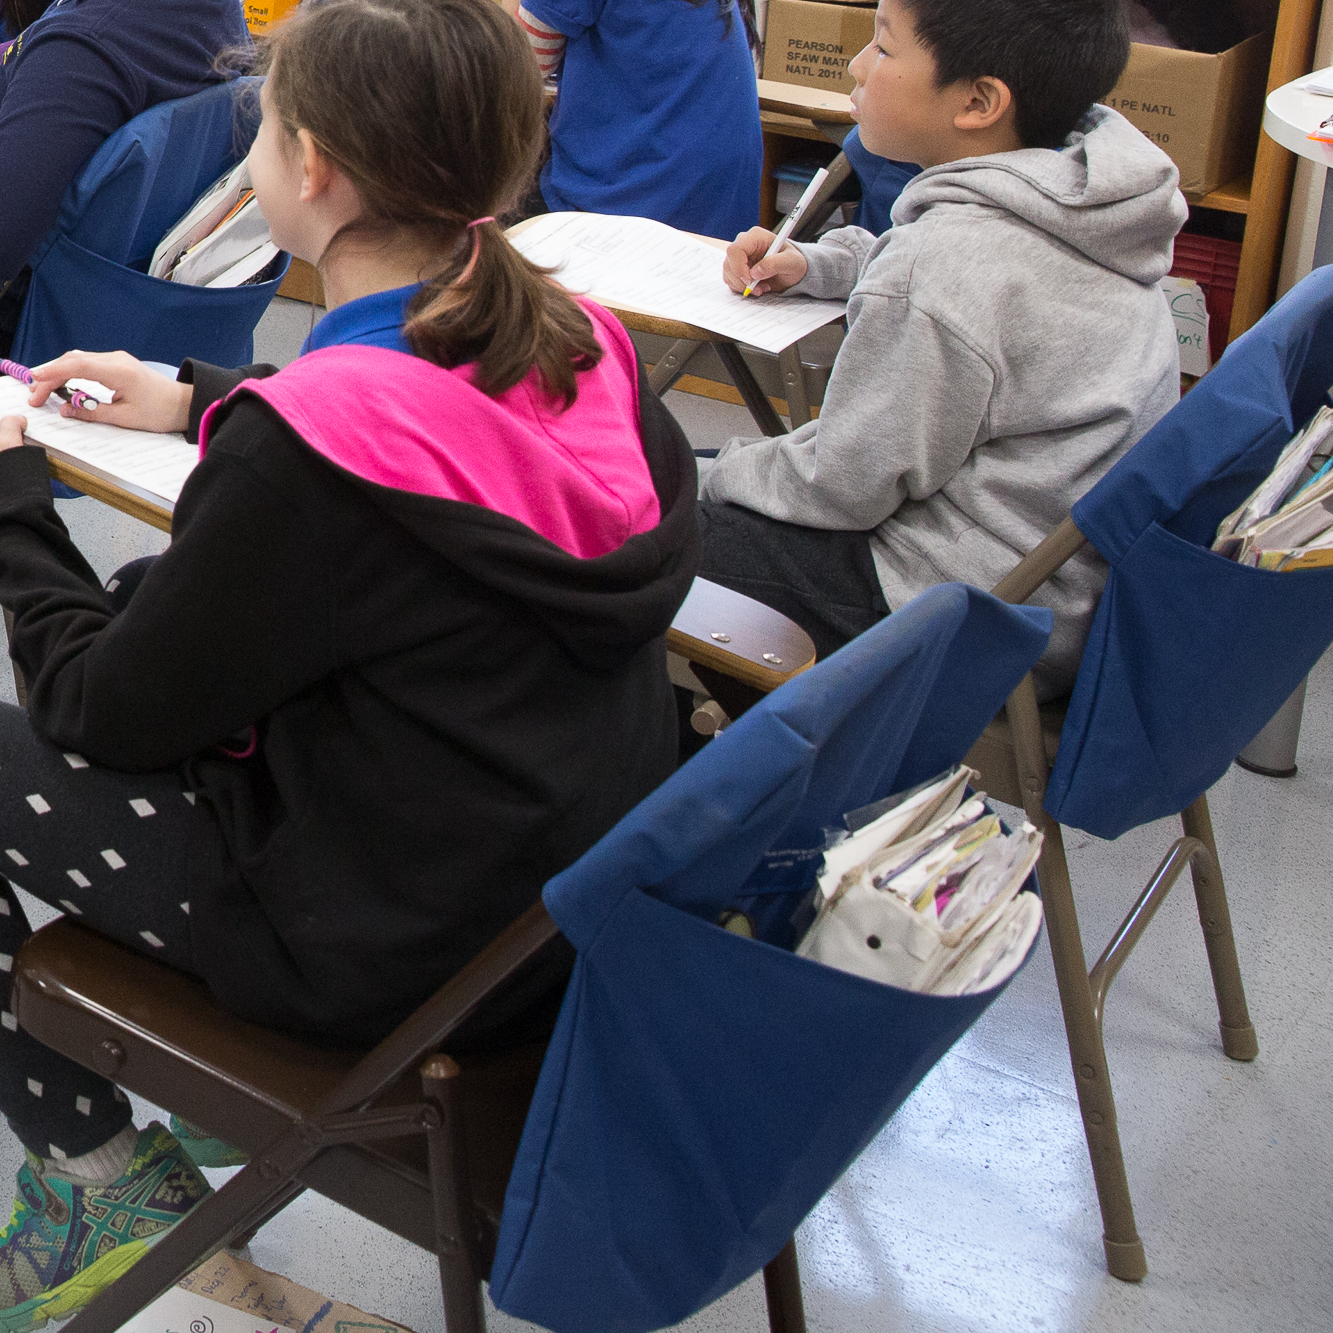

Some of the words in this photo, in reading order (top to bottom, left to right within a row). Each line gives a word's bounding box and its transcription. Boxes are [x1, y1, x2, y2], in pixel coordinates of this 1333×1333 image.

[248, 6, 269, 16] Small
[254, 17, 268, 27] Box
[788, 39, 843, 54] PEARSON
[786, 52, 820, 64] SFAW
[786, 64, 814, 76] NATL
[818, 68, 843, 80] 2011
[1121, 99, 1138, 110] PE
[1141, 103, 1176, 116] NATL
